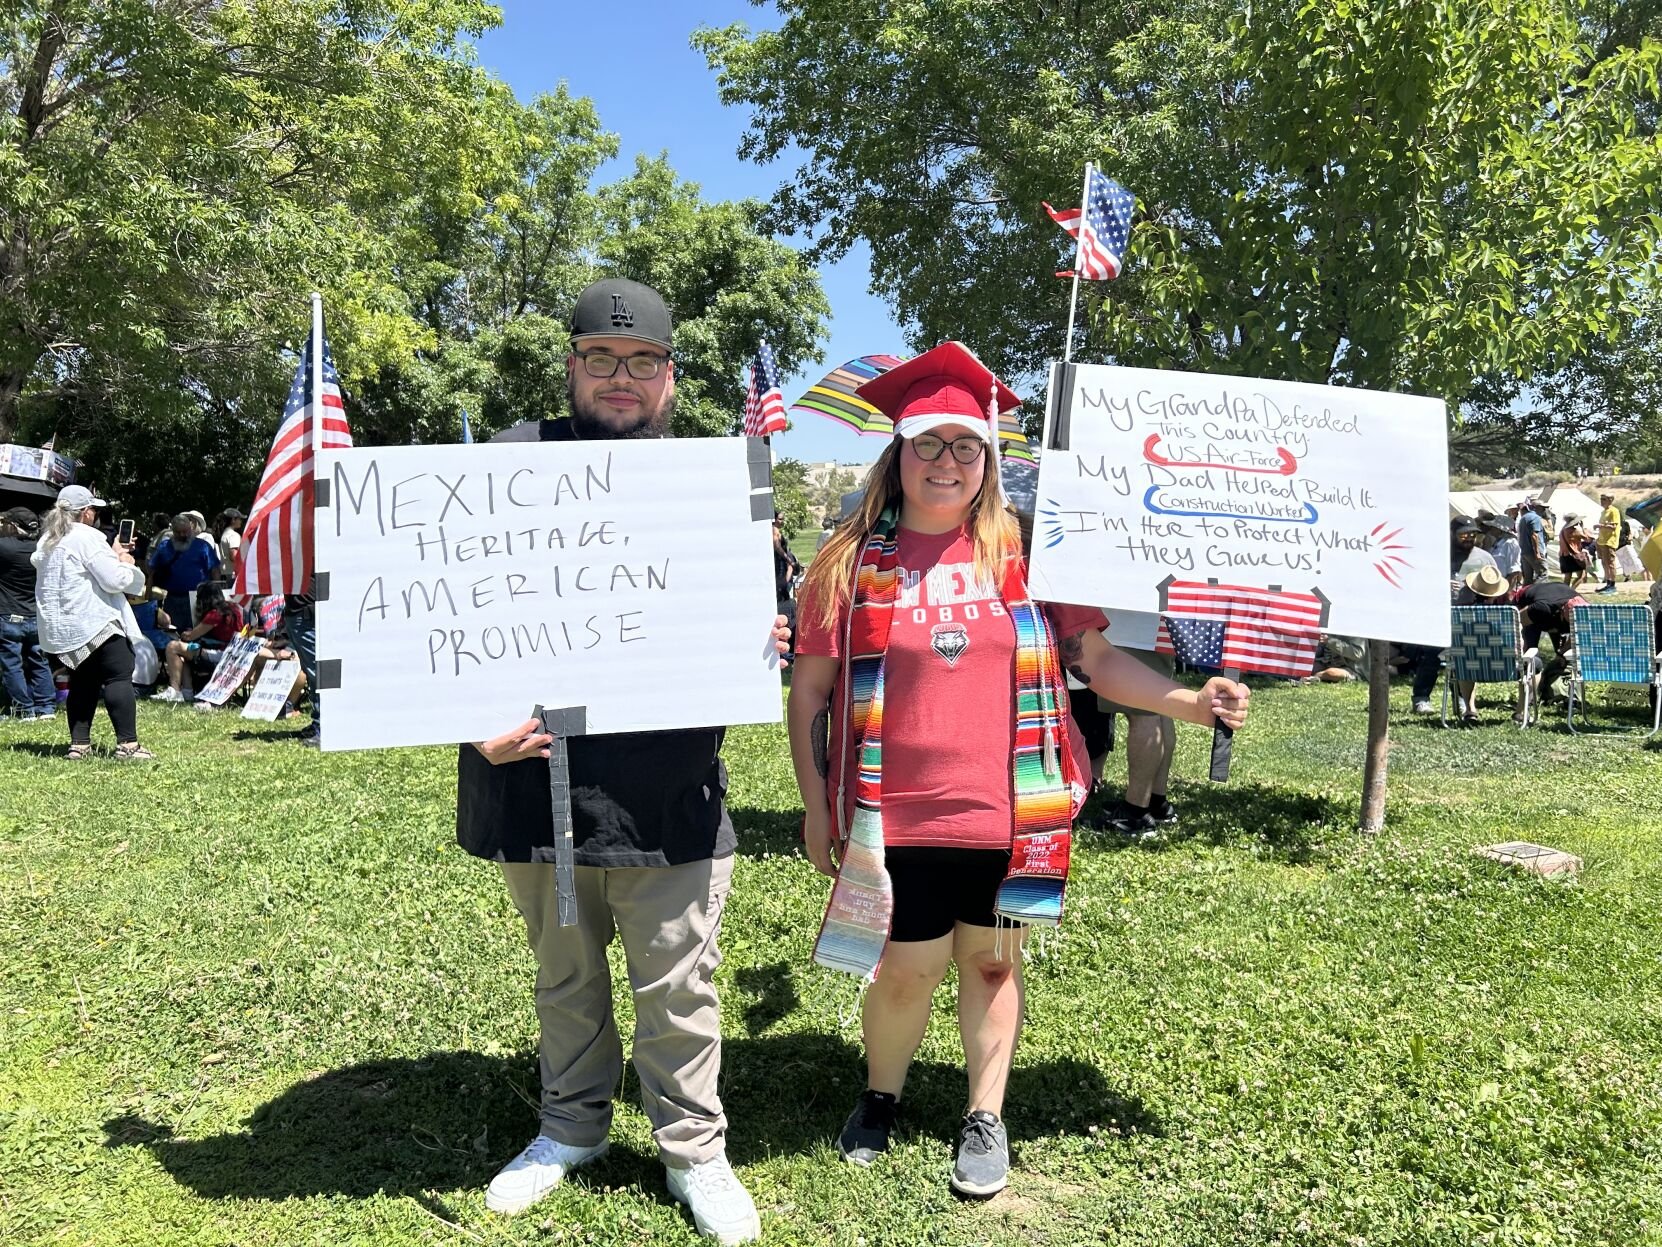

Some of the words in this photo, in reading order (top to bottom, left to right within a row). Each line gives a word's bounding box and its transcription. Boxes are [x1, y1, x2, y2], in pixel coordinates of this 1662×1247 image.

[611, 293, 634, 328] LA
[1080, 386, 1134, 432] My
[1253, 392, 1363, 436] Defended
[1146, 421, 1197, 440] This
[1167, 443, 1202, 463] US
[334, 451, 613, 538] MEXICAN
[1076, 454, 1131, 496] My
[1140, 462, 1216, 491] Dad
[1298, 478, 1356, 511] Build
[1158, 493, 1254, 514] Construction
[1255, 501, 1306, 519] Worker
[1060, 511, 1129, 533] I'm
[1195, 517, 1229, 539] to
[1233, 518, 1305, 545] Protect
[1309, 527, 1374, 552] What
[1205, 544, 1284, 567] Gave
[358, 557, 670, 633] AMERICAN
[891, 601, 1007, 626] OBOS
[428, 610, 648, 677] PROMISE
[1023, 844, 1047, 853] Class
[1048, 842, 1059, 851] of
[1031, 835, 1052, 845] UNM
[1025, 859, 1050, 868] First
[1026, 851, 1051, 860] 2022
[1010, 867, 1062, 875] Generation
